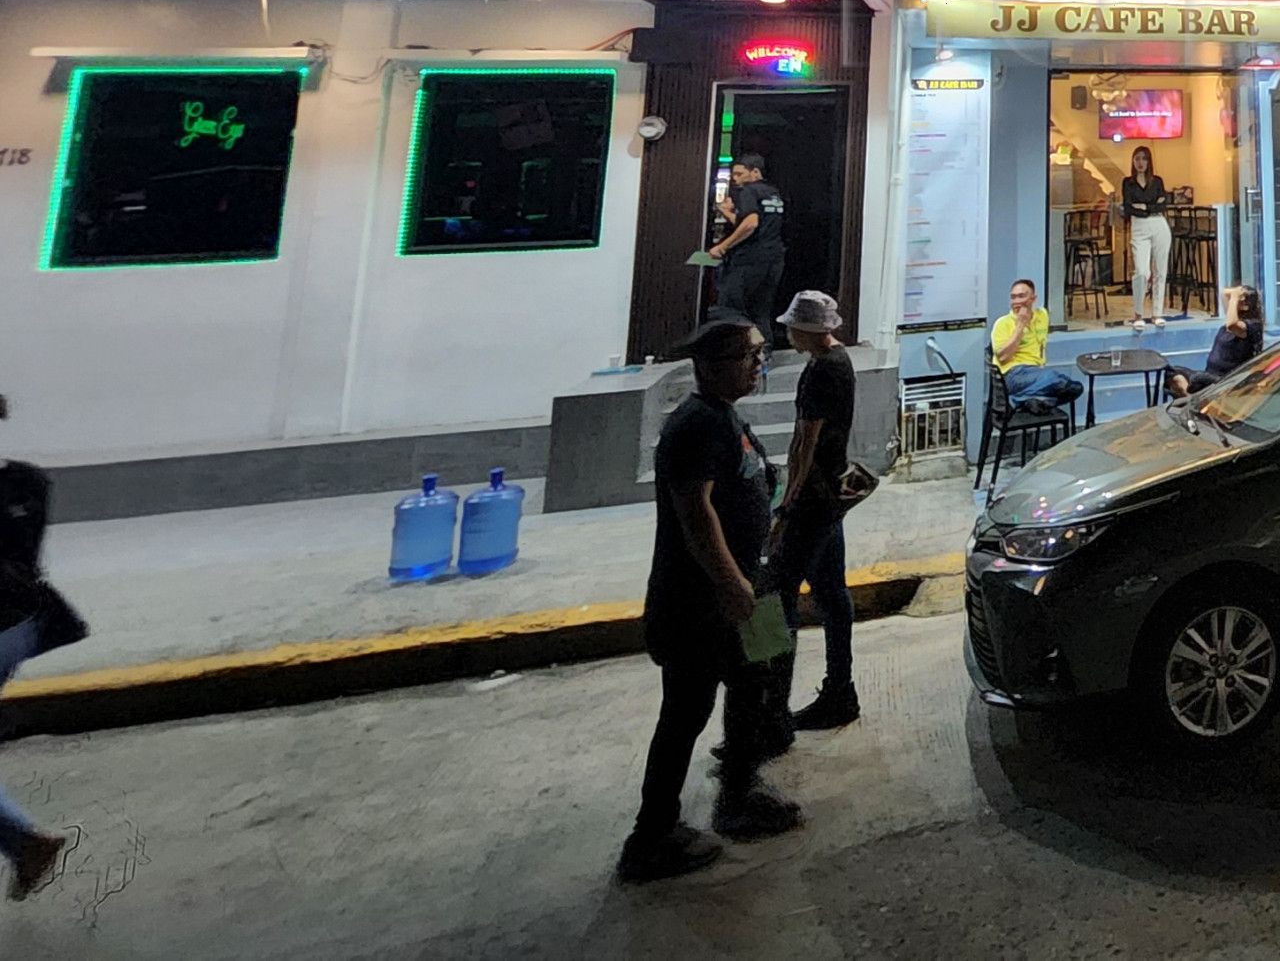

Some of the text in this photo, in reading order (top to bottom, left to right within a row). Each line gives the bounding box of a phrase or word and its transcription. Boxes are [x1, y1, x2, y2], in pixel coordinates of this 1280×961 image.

[990, 5, 1259, 36] JJ CAFE BAR
